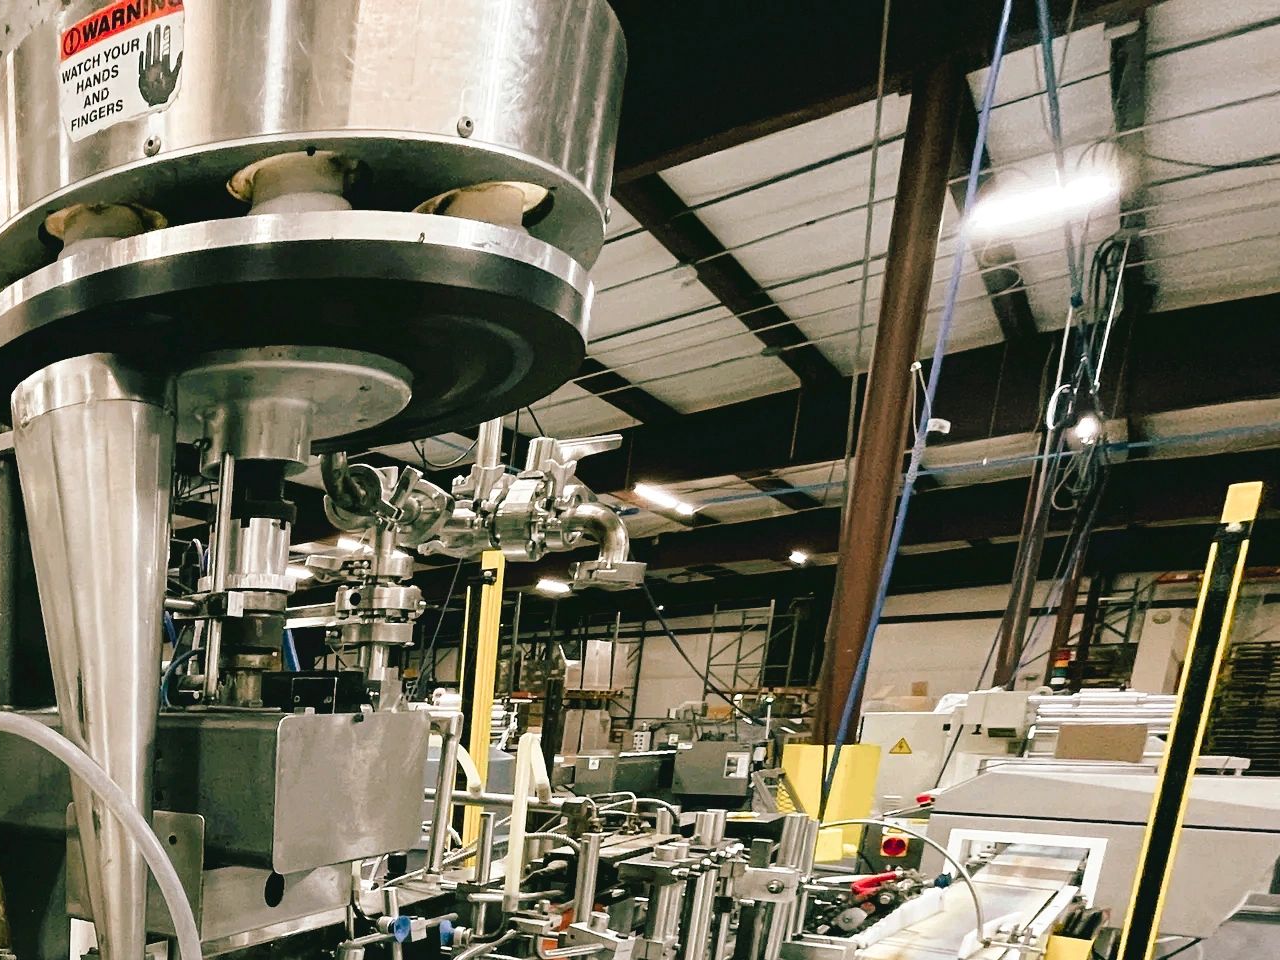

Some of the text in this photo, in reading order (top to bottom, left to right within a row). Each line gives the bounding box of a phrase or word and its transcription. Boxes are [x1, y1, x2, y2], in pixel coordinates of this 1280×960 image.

[62, 38, 140, 84] WATCH YOUR
[76, 65, 119, 95] HANDS
[84, 87, 110, 109] AND
[71, 99, 124, 132] FINGERS
